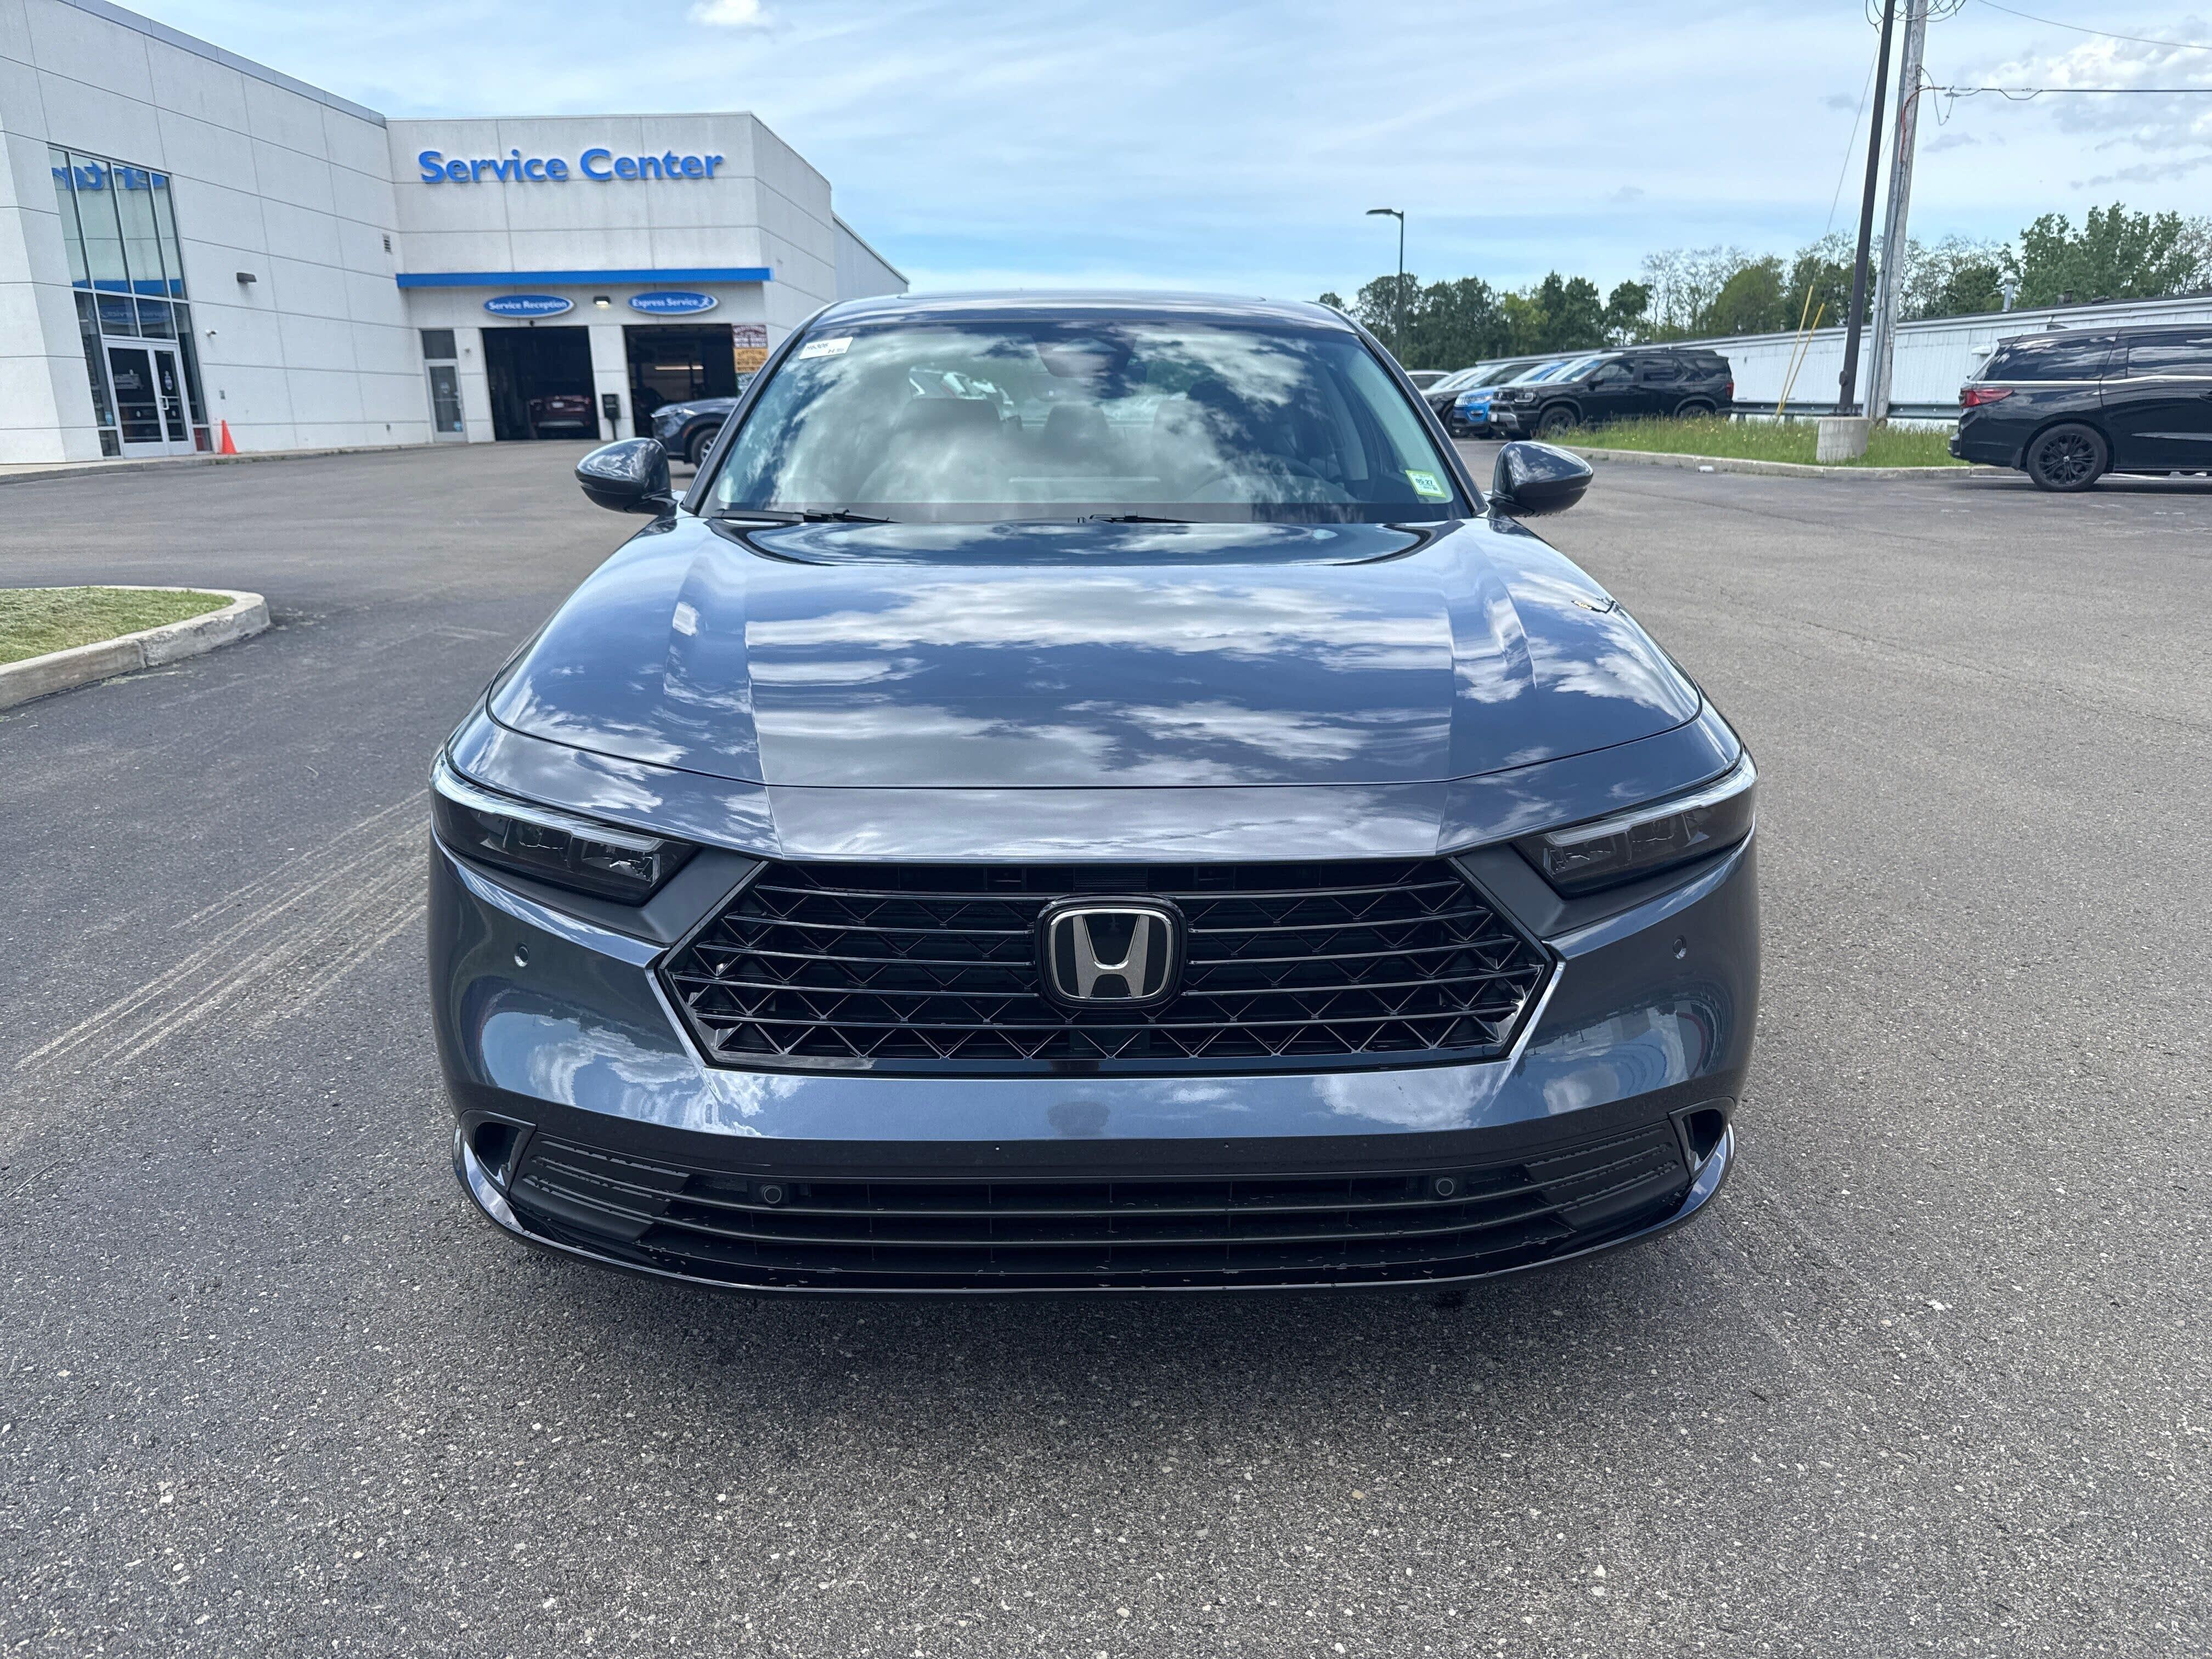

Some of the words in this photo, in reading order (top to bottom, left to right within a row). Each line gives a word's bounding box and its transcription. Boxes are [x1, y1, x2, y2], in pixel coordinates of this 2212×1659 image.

[419, 149, 569, 183] Service
[580, 148, 725, 182] Center
[488, 301, 522, 309] Service
[523, 300, 567, 310] Reception
[632, 298, 665, 308] Express
[666, 297, 698, 307] Service
